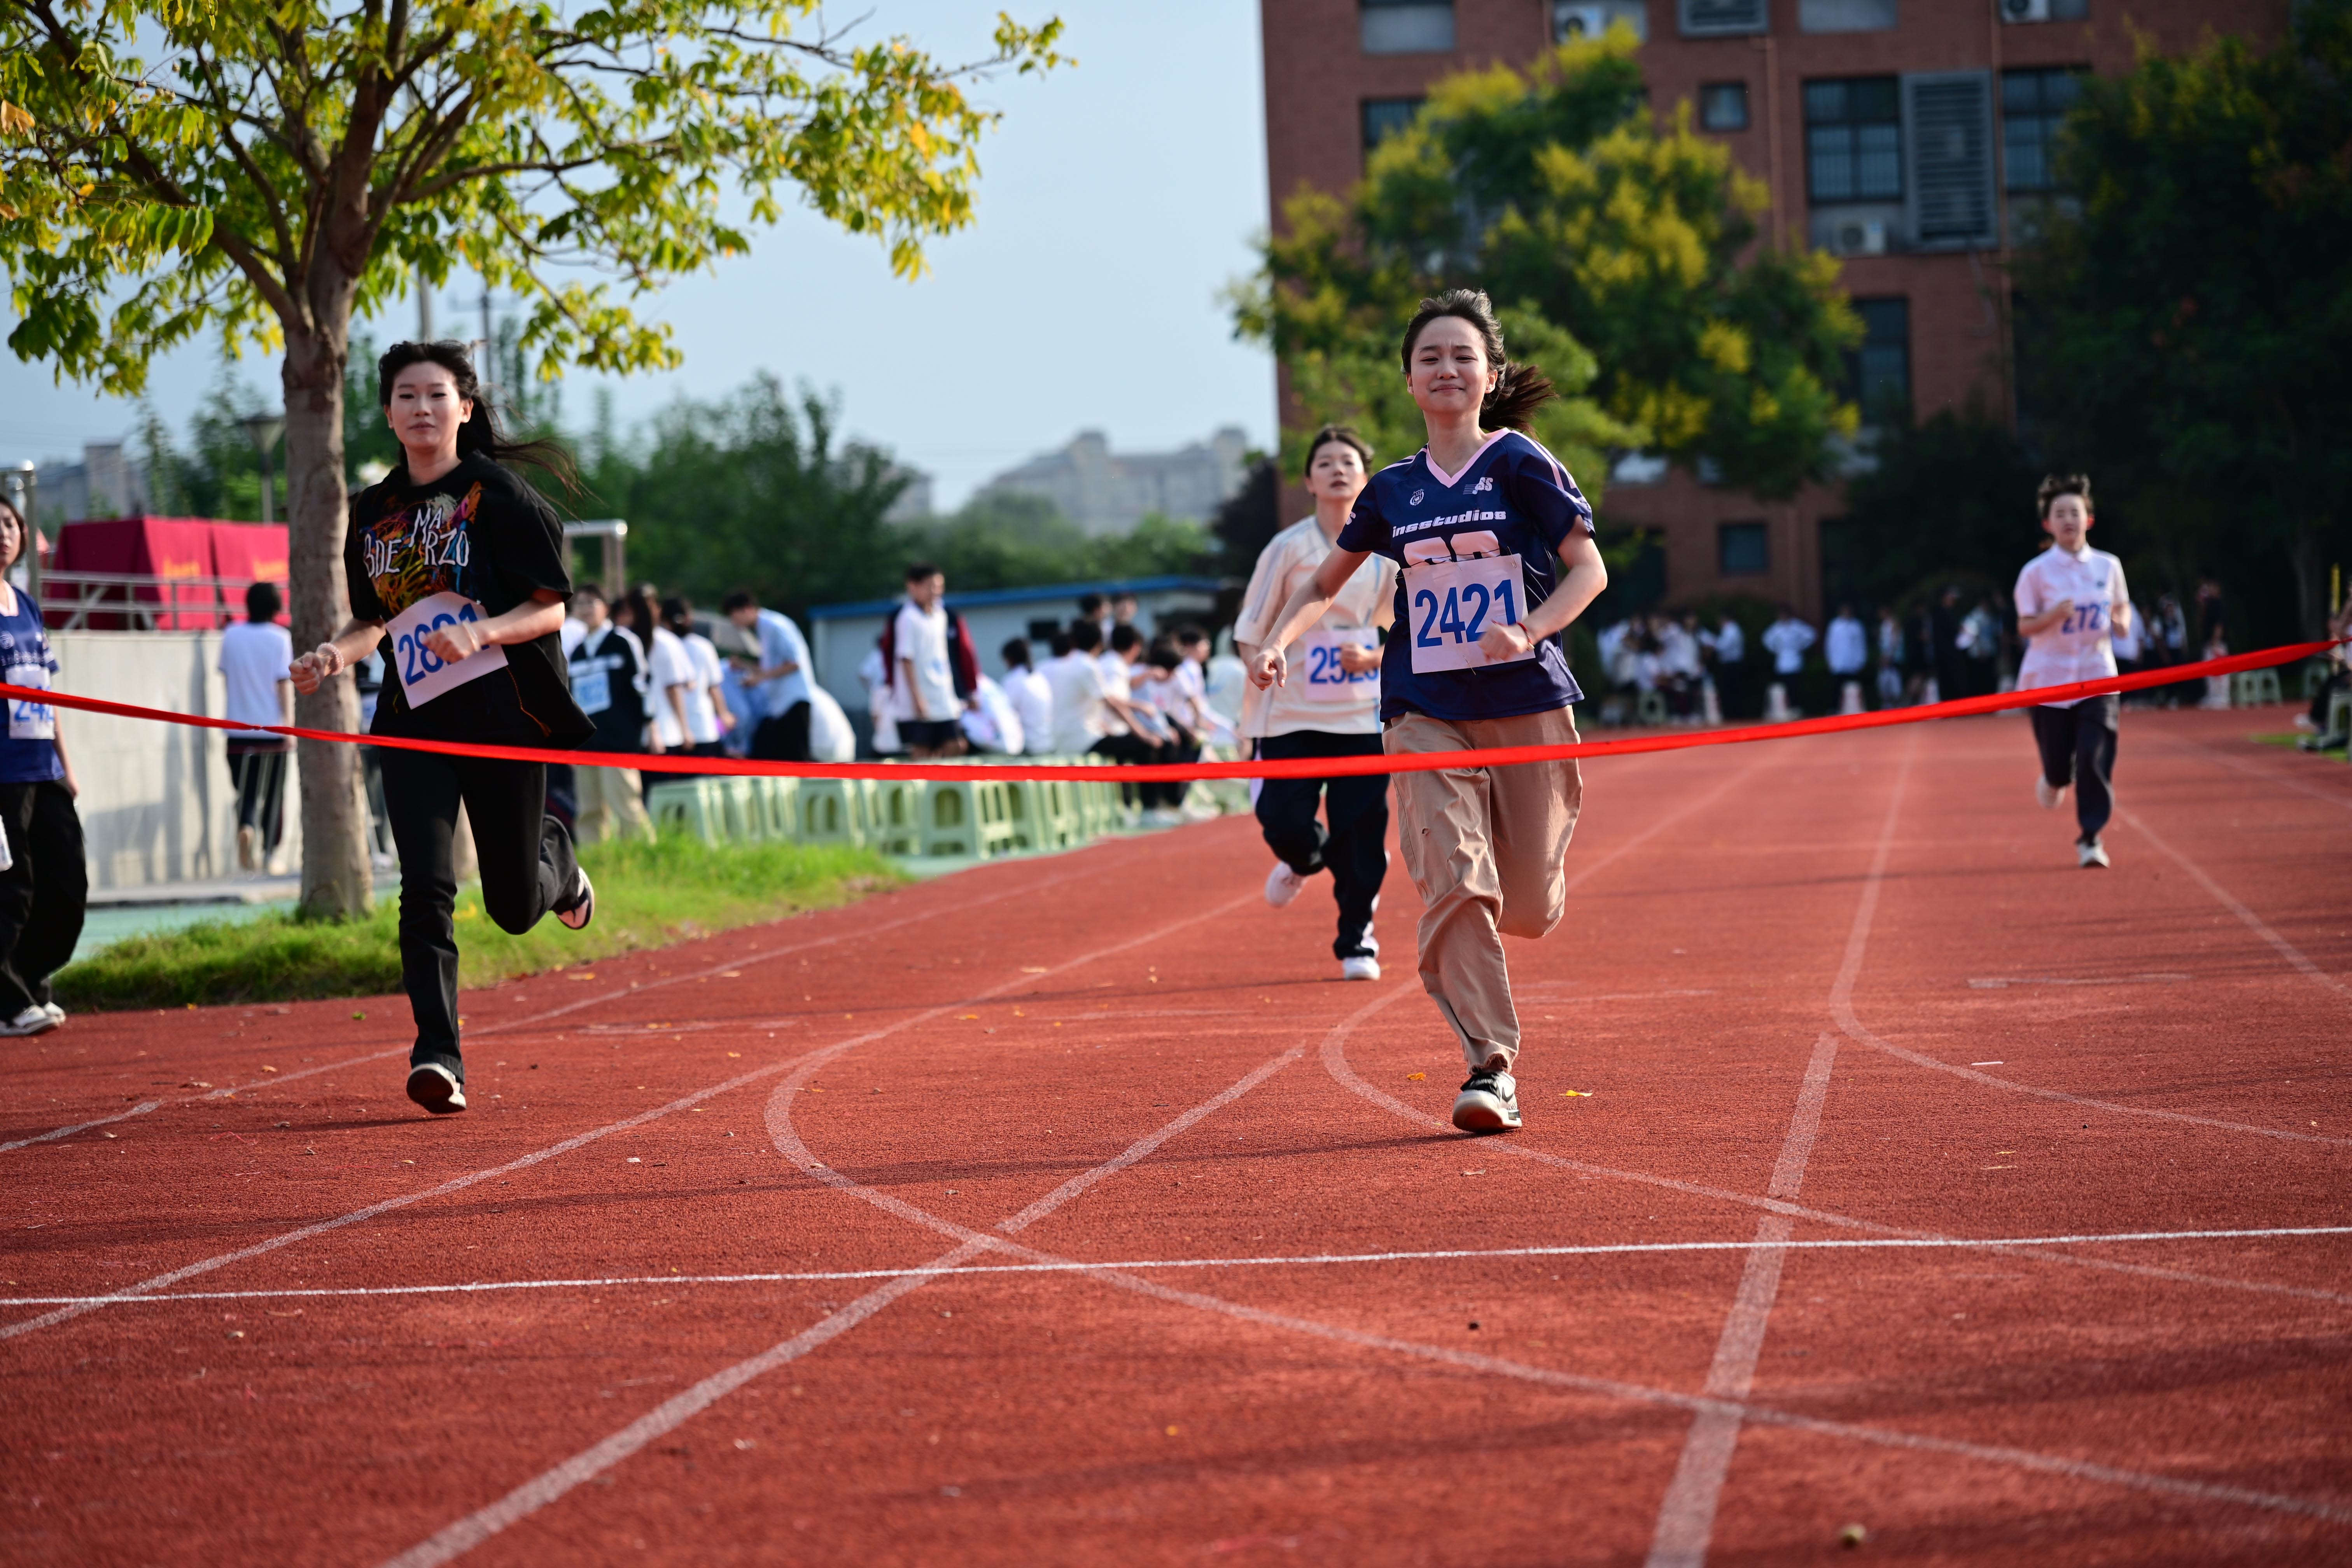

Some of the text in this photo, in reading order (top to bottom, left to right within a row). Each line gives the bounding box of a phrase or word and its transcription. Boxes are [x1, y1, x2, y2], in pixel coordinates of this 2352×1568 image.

[1393, 508, 1507, 538] insstudios
[399, 603, 490, 686] 281
[1415, 579, 1517, 648] 2421
